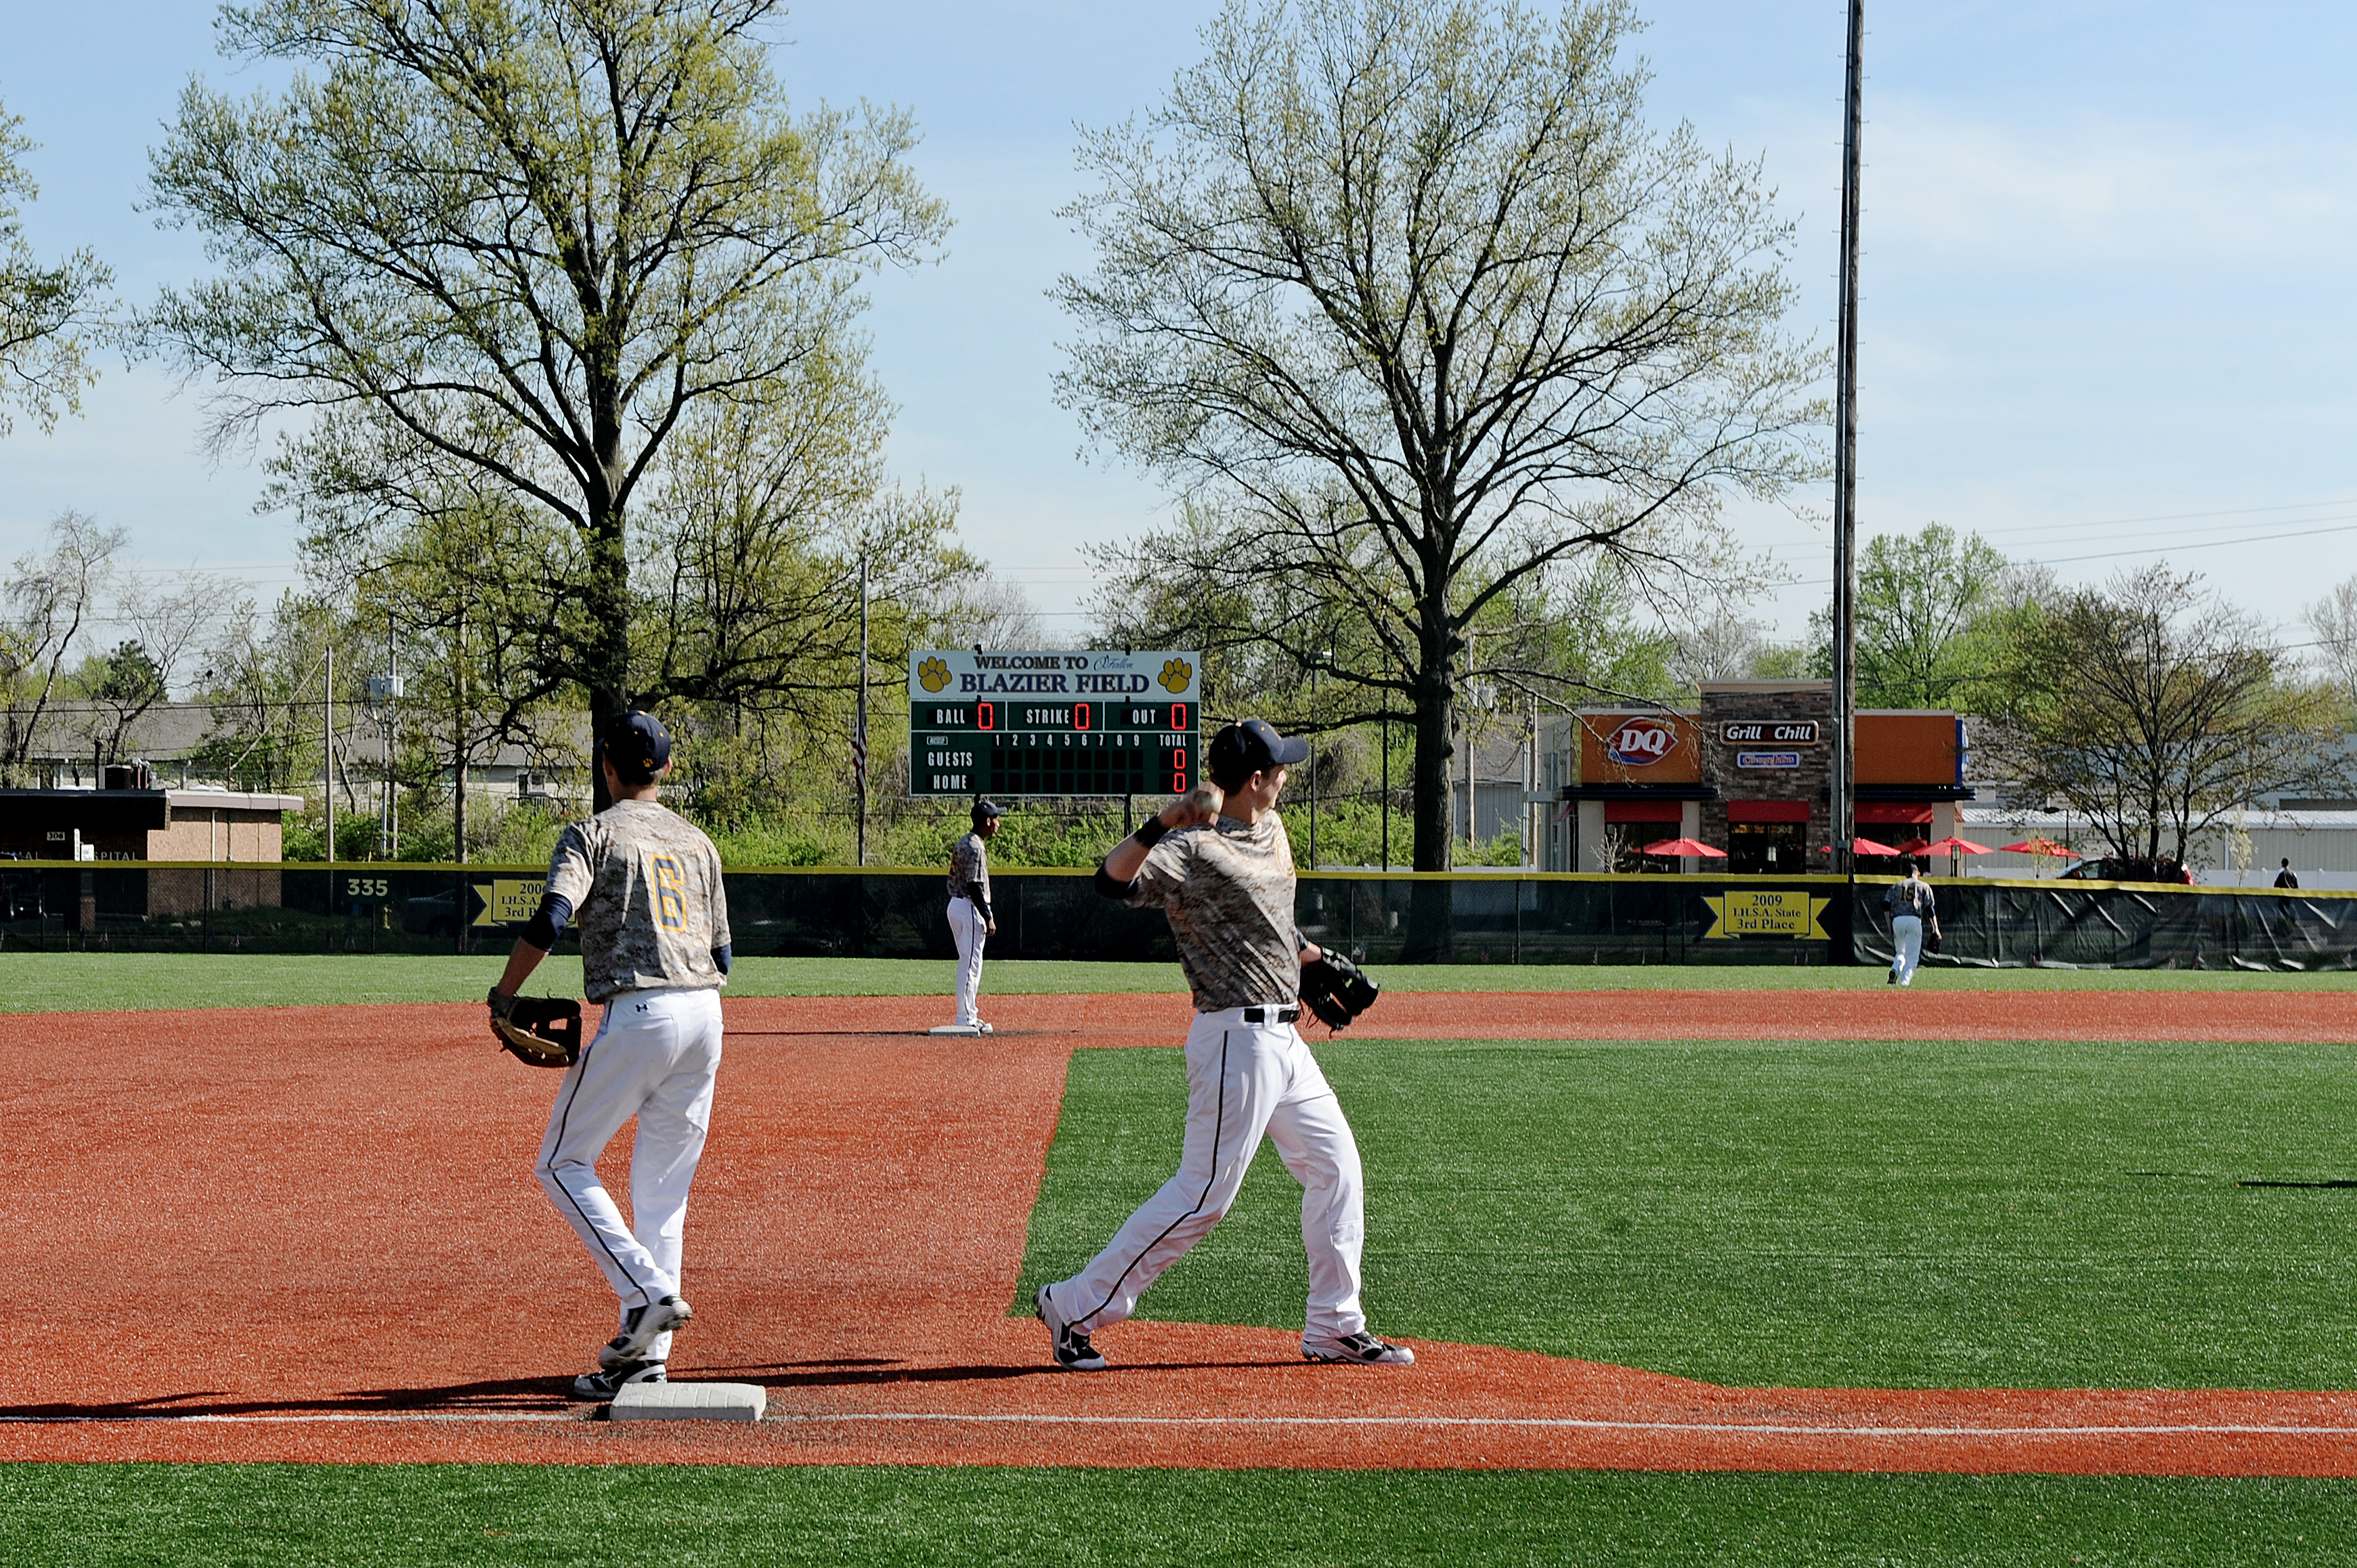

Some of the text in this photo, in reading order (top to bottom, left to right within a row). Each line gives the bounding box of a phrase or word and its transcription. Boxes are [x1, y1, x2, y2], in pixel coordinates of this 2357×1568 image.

[974, 656, 1060, 670] WELCOME
[1064, 656, 1089, 670] TO
[959, 674, 1150, 693] BLAZIER FIELD
[936, 709, 965, 724] BALL
[978, 703, 993, 731] 0
[1026, 709, 1069, 724] STRIKE
[1075, 703, 1090, 731] 0
[1132, 709, 1156, 724] OUT
[1171, 703, 1186, 731] 0
[995, 734, 1187, 747] 1 2 3 4 5 6 7 8 9 TOTAL
[1727, 726, 1761, 739] Grill
[1774, 726, 1811, 740] Chill
[1619, 729, 1666, 756] DQ
[928, 752, 973, 767] GUESTS
[1173, 749, 1186, 769] 0
[933, 775, 967, 789] HOME
[1173, 772, 1186, 793] 0
[347, 878, 388, 897] 335
[649, 854, 687, 934] 6
[1752, 894, 1783, 907] 2009
[505, 907, 524, 917] 3rd
[1775, 908, 1802, 918] State
[1737, 919, 1796, 930] 3rd Place
